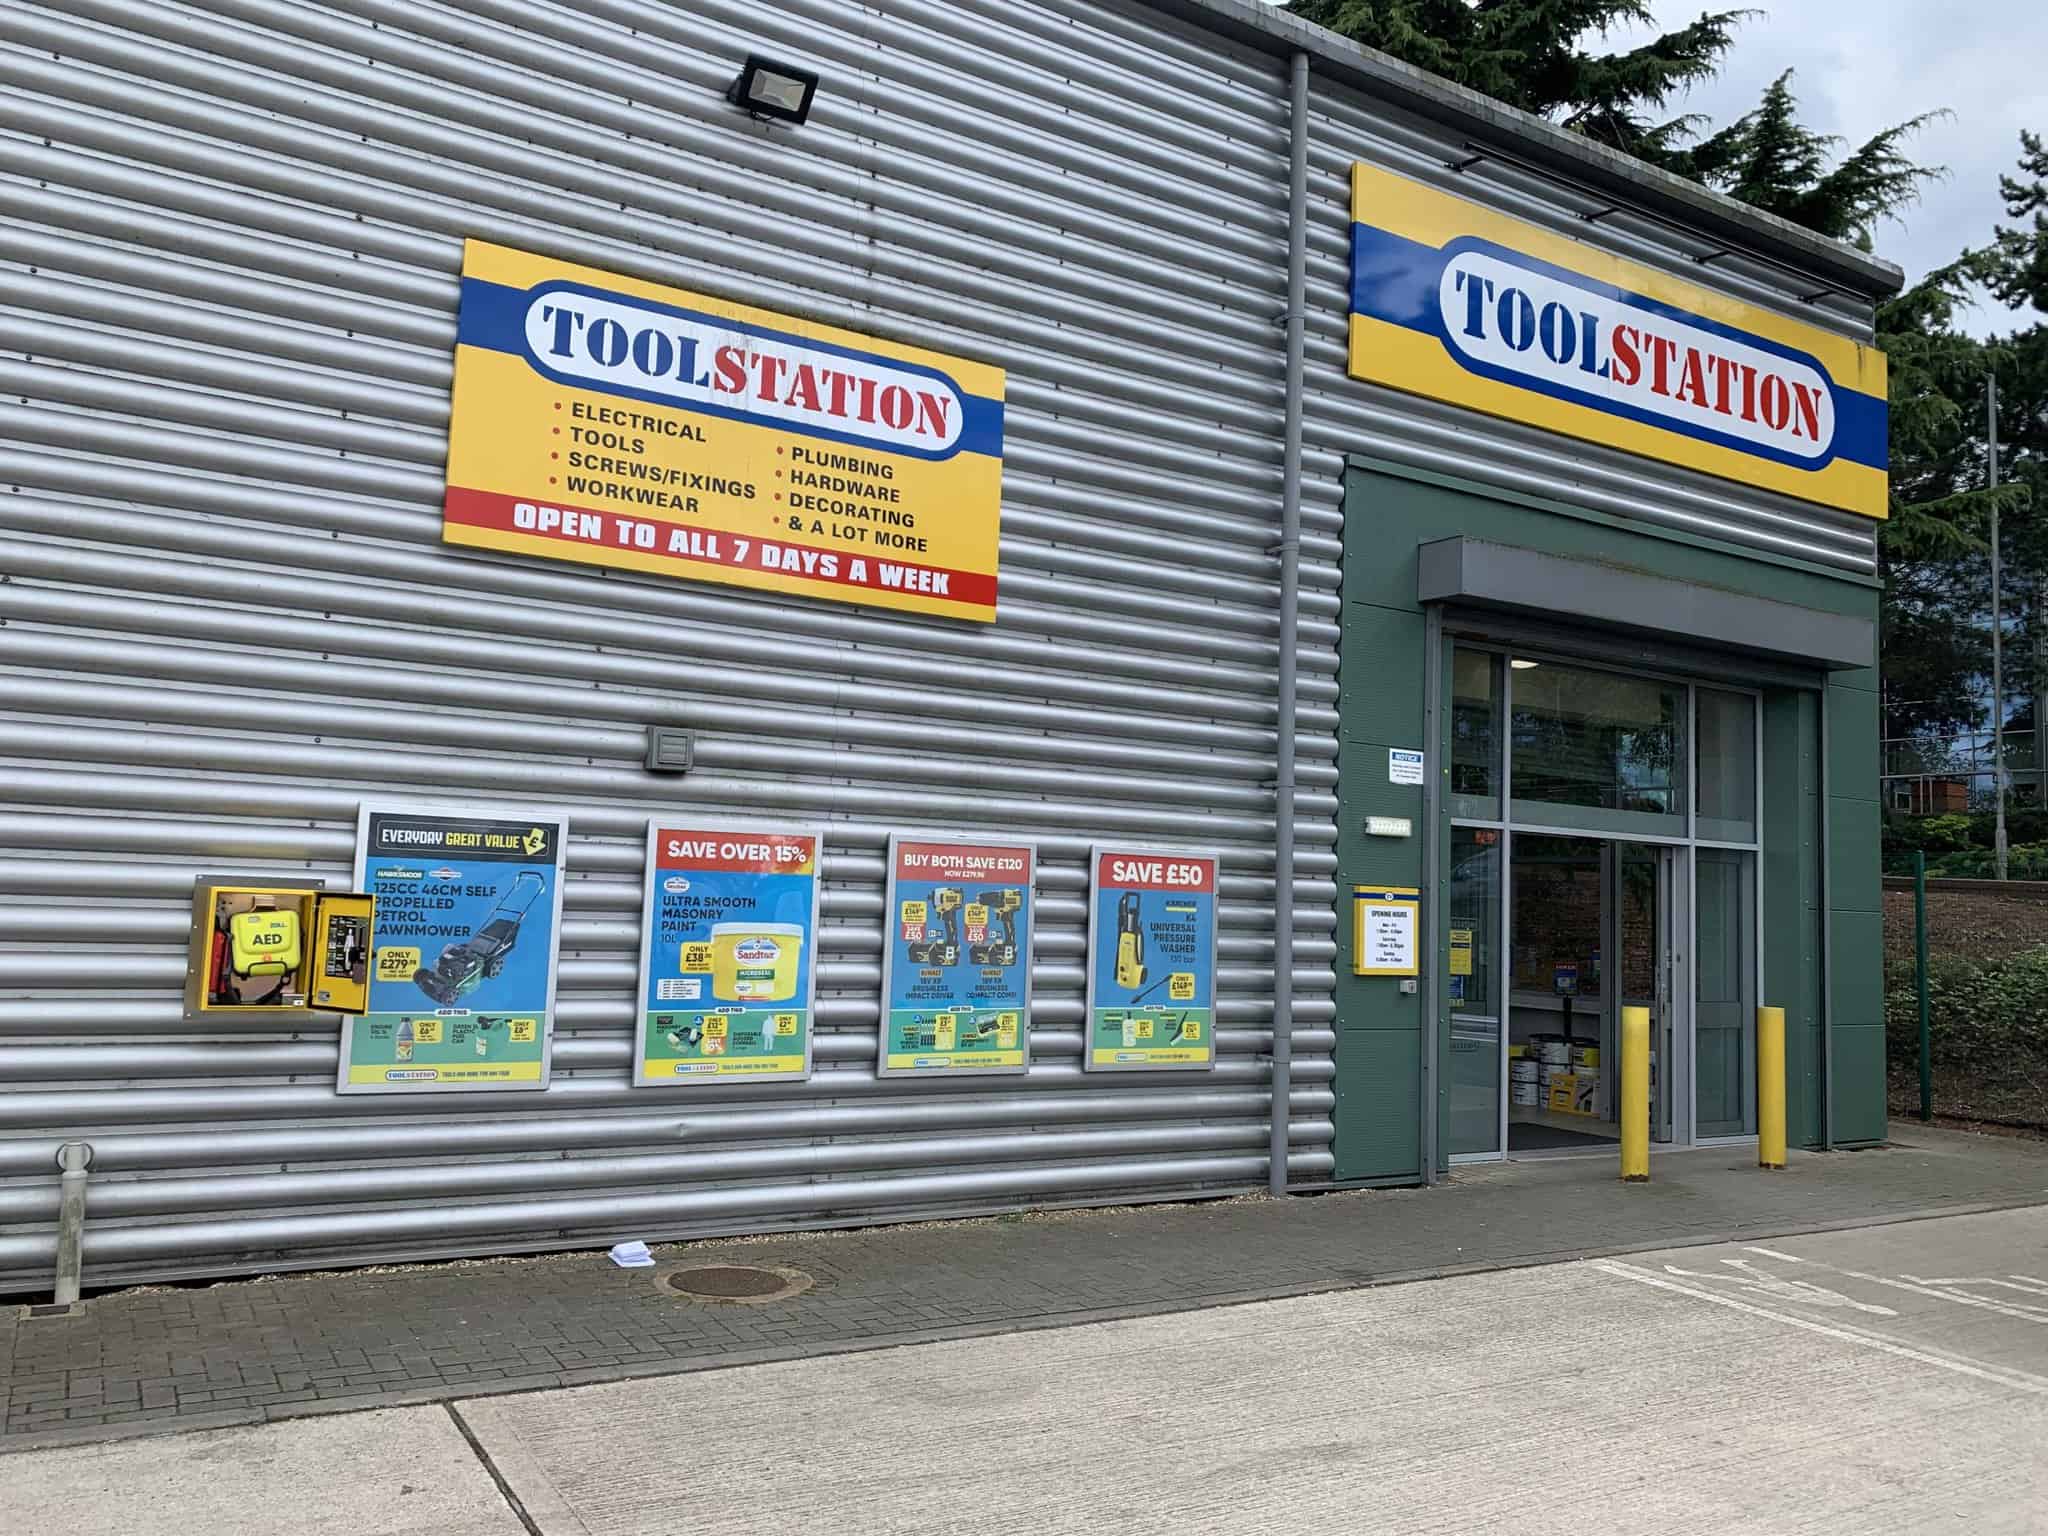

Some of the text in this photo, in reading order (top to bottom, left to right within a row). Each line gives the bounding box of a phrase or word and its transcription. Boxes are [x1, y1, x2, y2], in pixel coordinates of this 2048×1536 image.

[1455, 269, 1823, 442] TOOLSTATION
[543, 305, 951, 439] TOOLSTATION
[571, 402, 707, 443] ELECTRICAL
[570, 426, 645, 455] TOOLS
[791, 446, 894, 480] PLUMBING
[568, 450, 756, 500] SCREWS/FIXINGS
[566, 475, 700, 514] WORKWEAR
[790, 469, 901, 503] HARDWARE
[789, 492, 915, 529] DECORATING
[788, 515, 928, 553] & A LOT MORE
[513, 502, 951, 596] OPEN TO ALL 7 DAYS A WEEK
[382, 829, 443, 845] EVERYDAY
[445, 832, 482, 847] GREAT
[485, 834, 521, 849] VALUE
[668, 840, 807, 863] SAVE OVER 15%
[904, 854, 1023, 870] BUY BOTH SAVE £120
[1112, 861, 1203, 886] SAVE £50
[374, 882, 497, 897] 125CC 46CM SELF
[375, 896, 455, 910] PROPELLED
[662, 896, 757, 909] ULTRA SMOOTH
[374, 910, 427, 922] PETROL
[661, 909, 724, 920] MASONRY
[661, 921, 697, 931] PAINT
[1150, 922, 1196, 932] UNIVERSAL
[253, 933, 283, 945] AED
[661, 934, 677, 943] 10L
[1154, 933, 1196, 943] PRESSURE
[1160, 943, 1196, 953] WASHER
